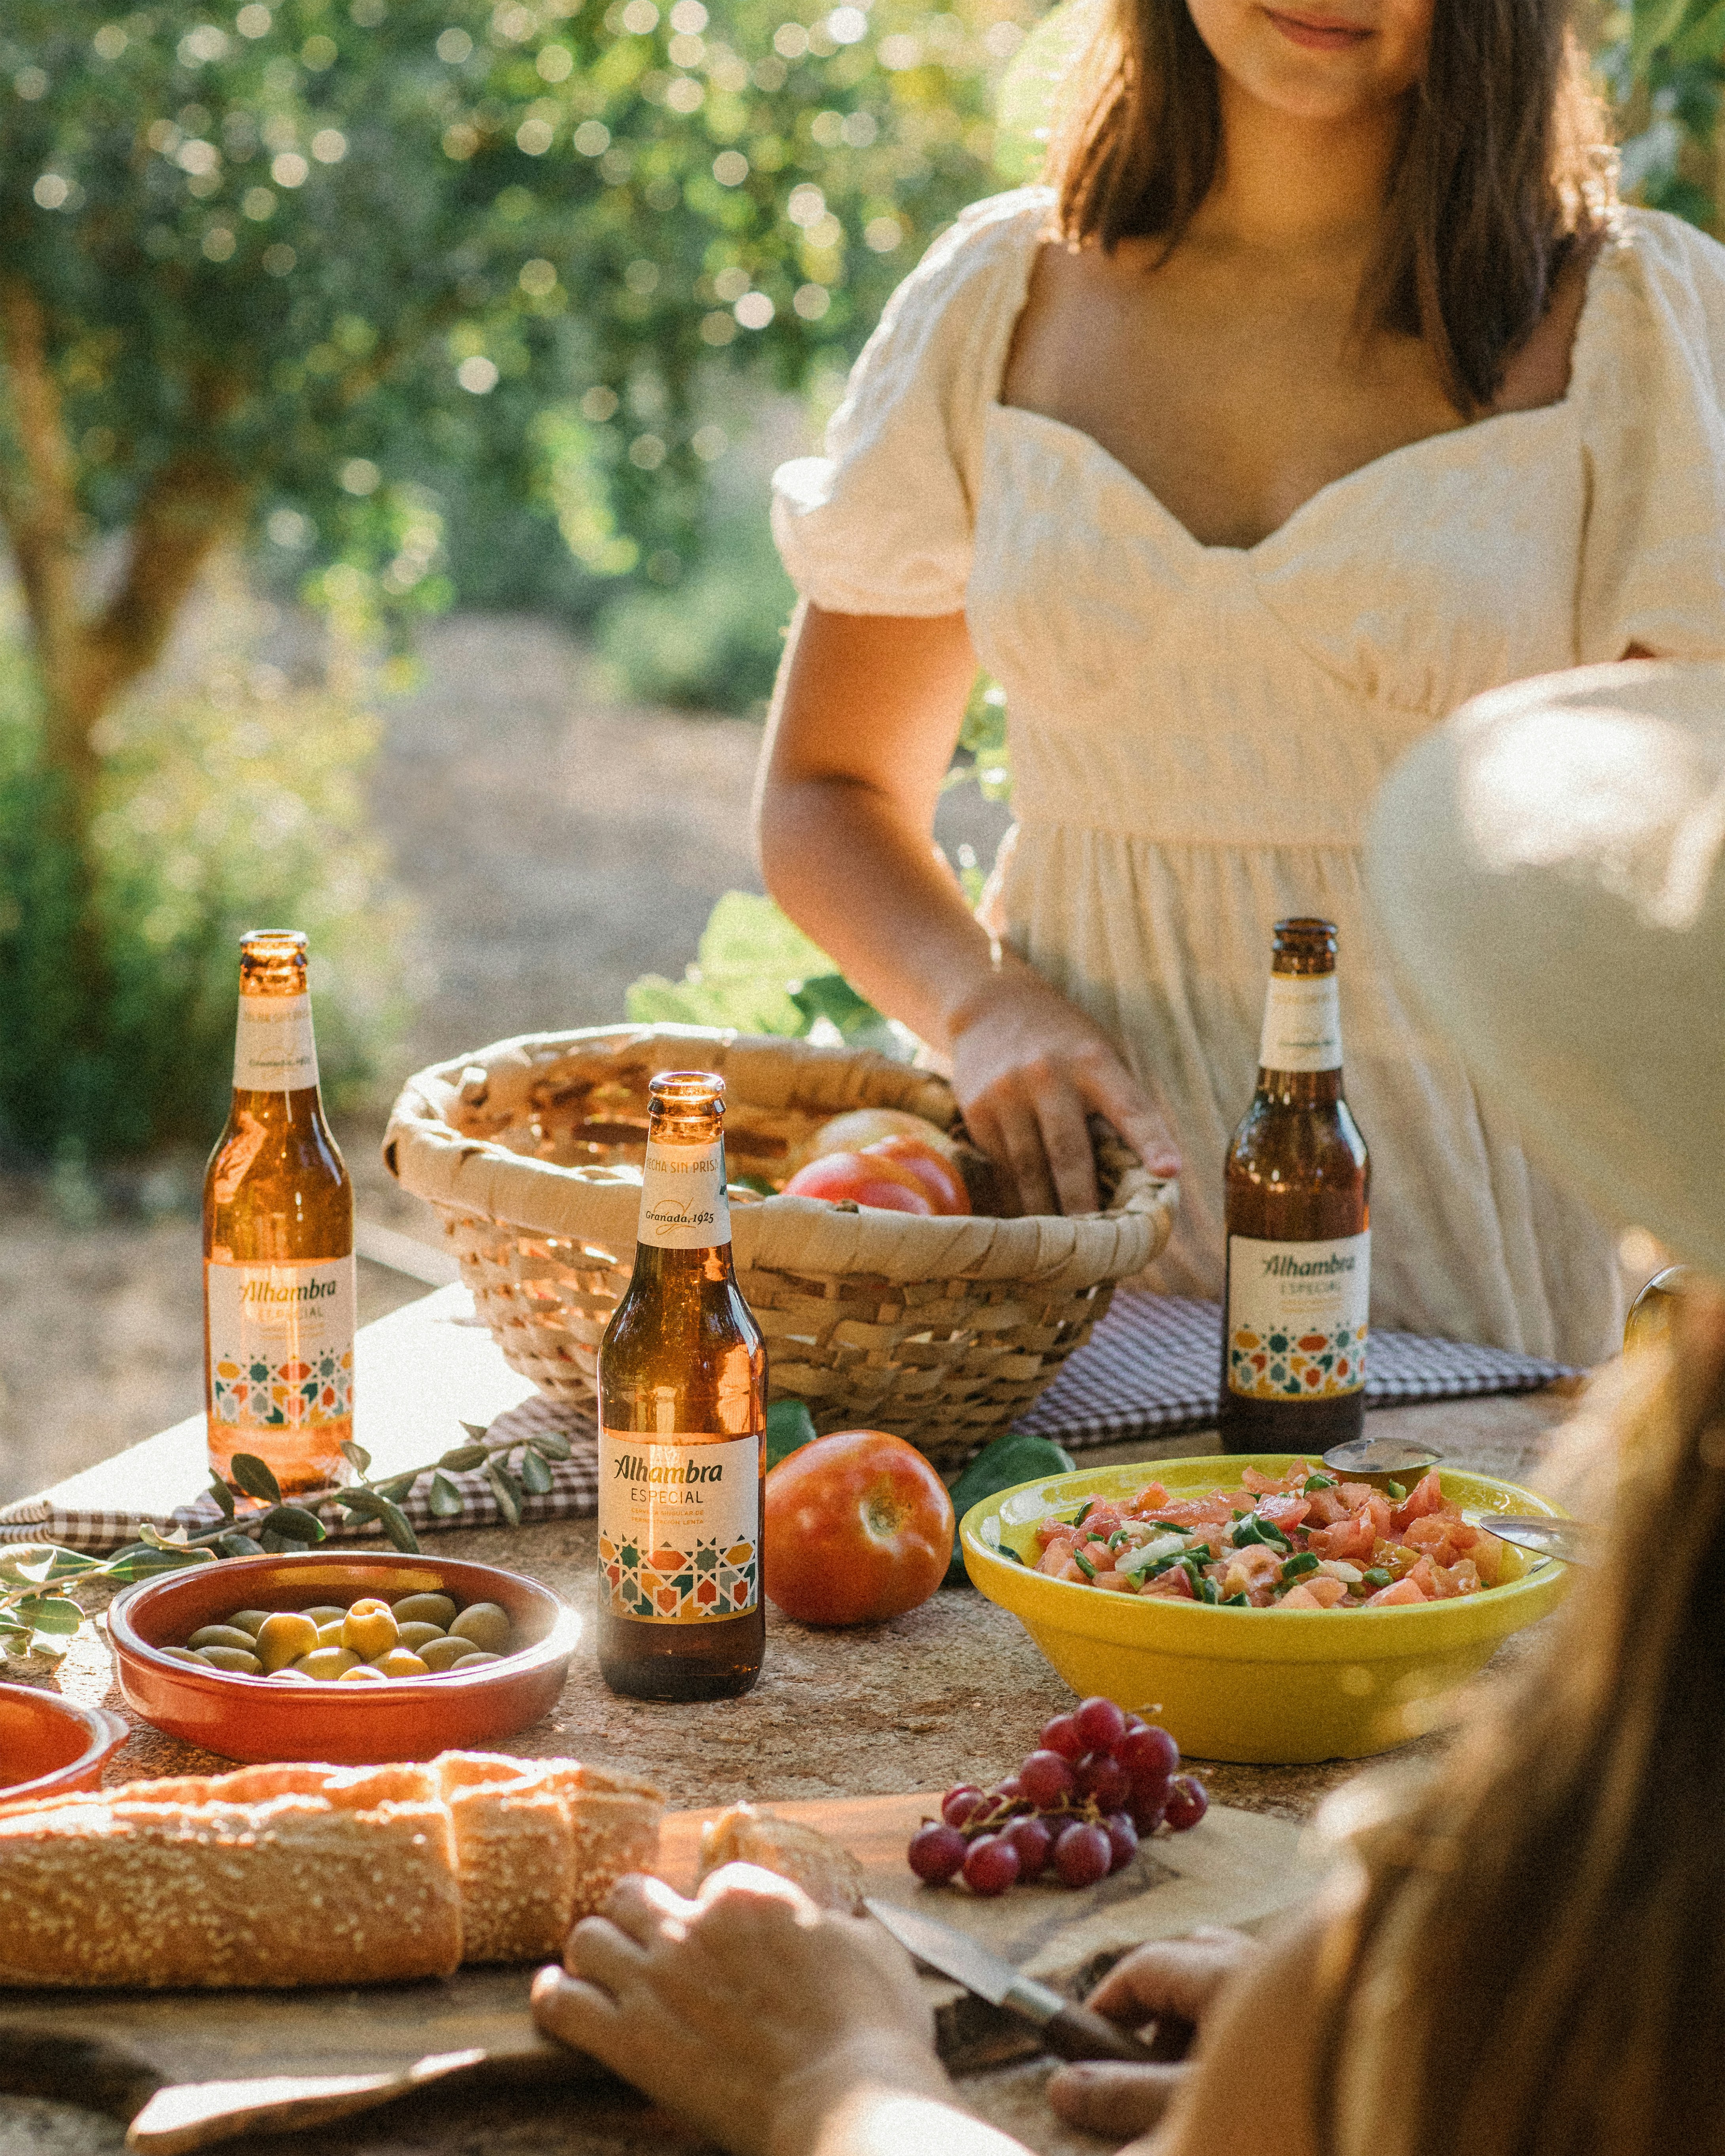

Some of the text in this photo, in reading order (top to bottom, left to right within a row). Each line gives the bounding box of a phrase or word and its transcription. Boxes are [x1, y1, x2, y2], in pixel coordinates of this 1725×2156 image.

[646, 1157, 719, 1173] HECHA SIN PRISA
[646, 1211, 714, 1225] Granada, 1925
[1262, 1252, 1355, 1277] Alhambra
[239, 1278, 336, 1302] Alhambra
[613, 1454, 723, 1484] Alhambra
[631, 1488, 704, 1504] ESPECIAL
[631, 1517, 680, 1525] FERMETACIÓN
